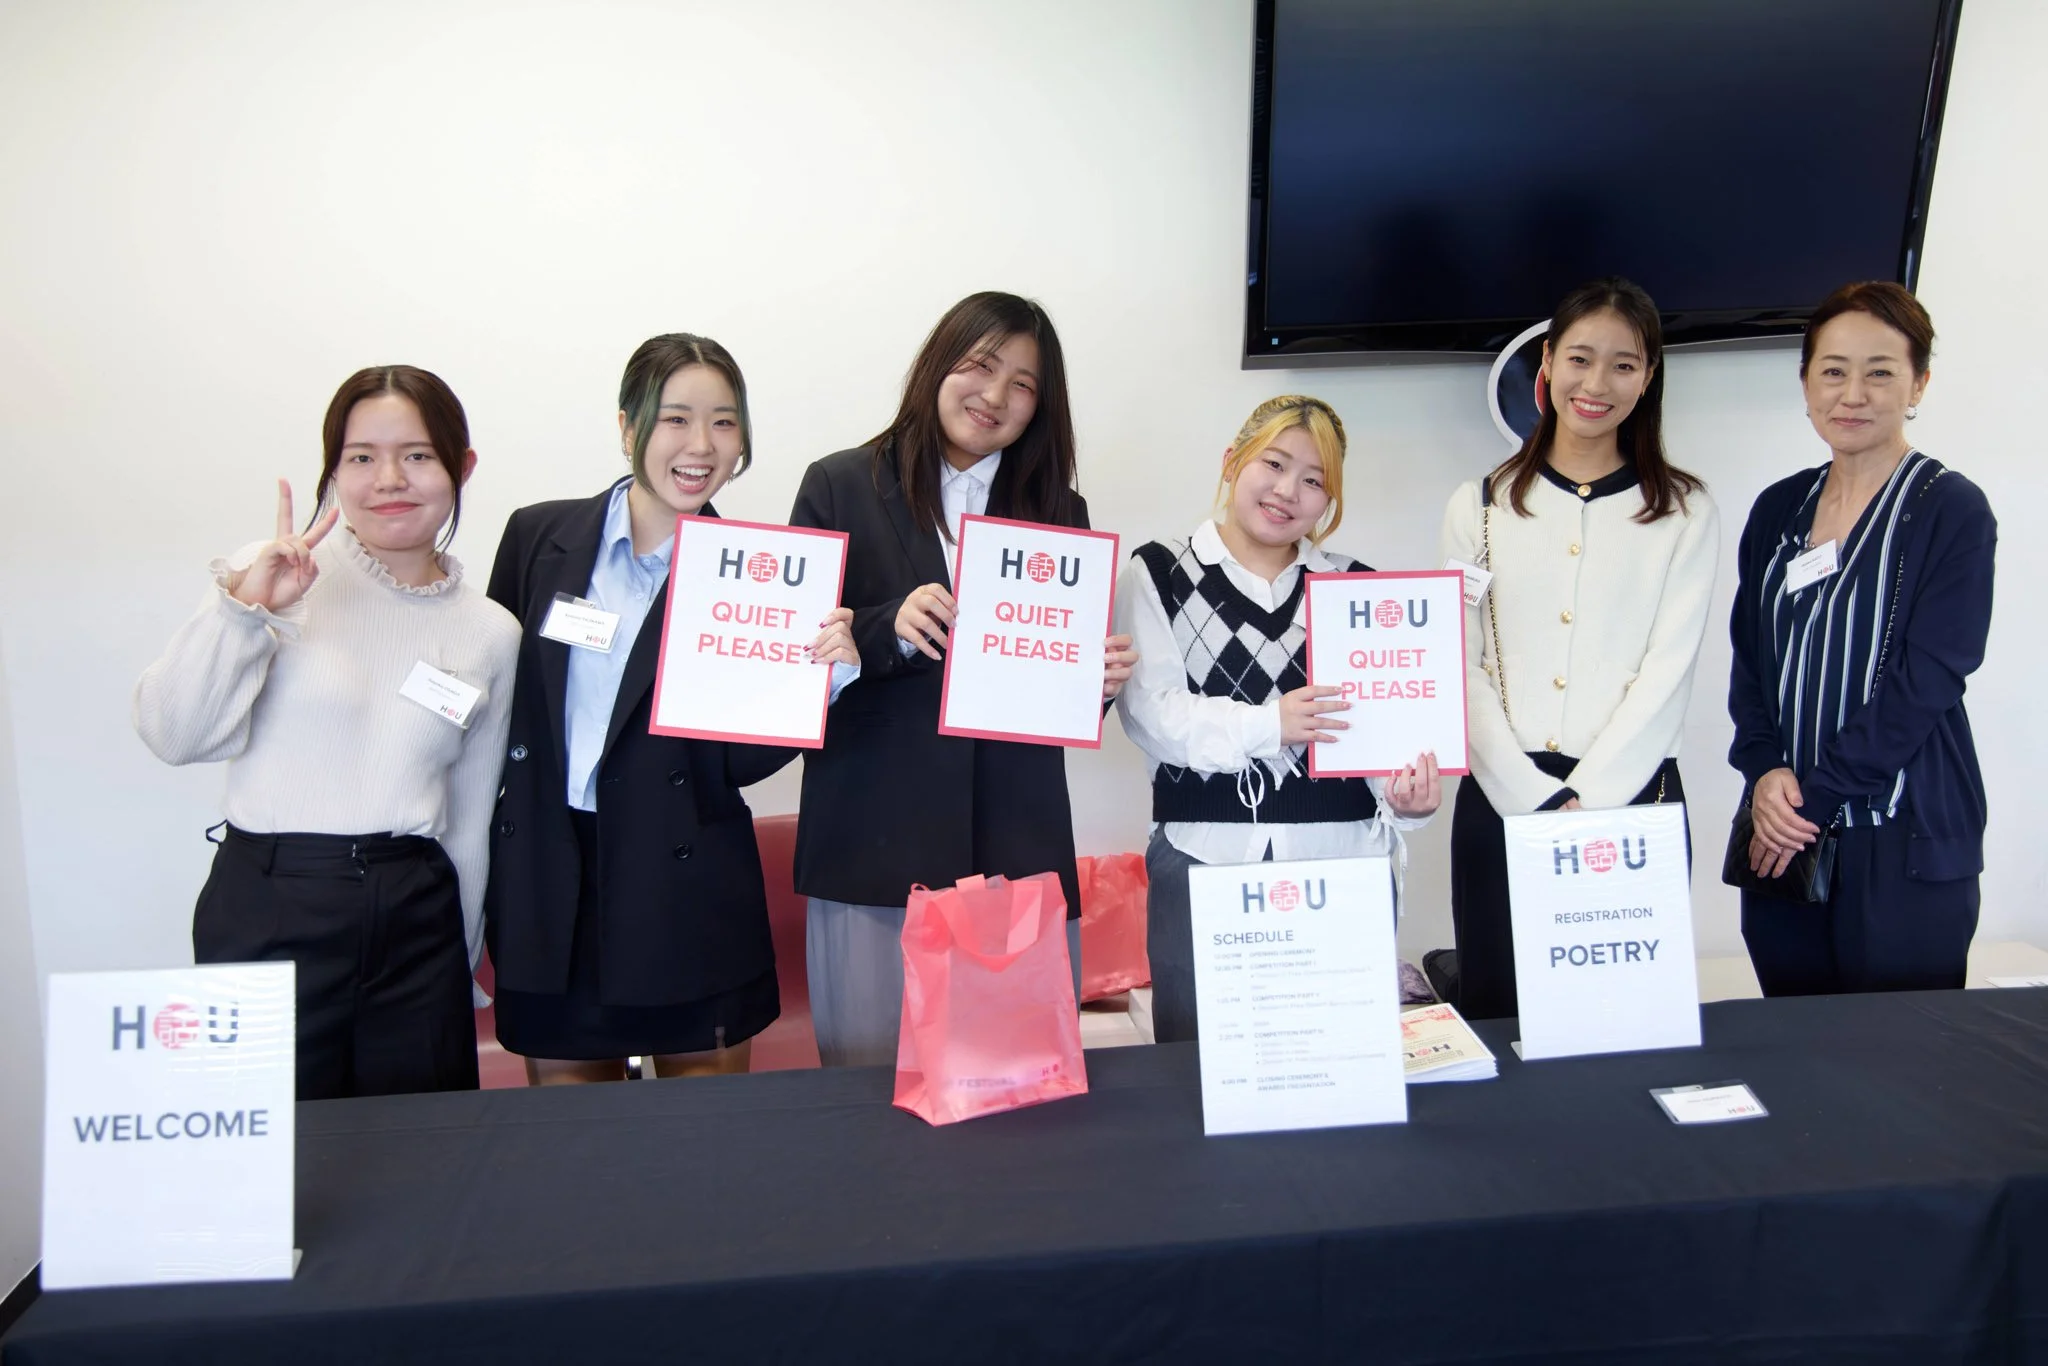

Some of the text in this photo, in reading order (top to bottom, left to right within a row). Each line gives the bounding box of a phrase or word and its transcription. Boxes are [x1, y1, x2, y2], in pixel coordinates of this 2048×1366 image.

[711, 601, 797, 630] QUIET
[995, 601, 1074, 629] QUIET
[697, 633, 803, 665] PLEASE
[982, 633, 1080, 664] PLEASE
[1348, 648, 1427, 670] QUIET
[1340, 679, 1436, 700] PLEASE
[1554, 907, 1653, 925] REGISTRATION
[1213, 929, 1294, 946] SCHEDULE
[1550, 939, 1660, 968] POETRY
[1256, 1075, 1286, 1083] CLOSING
[1286, 1073, 1324, 1081] CEREMONY
[1257, 1083, 1286, 1092] AWARDS
[73, 1109, 269, 1143] WELCOME
